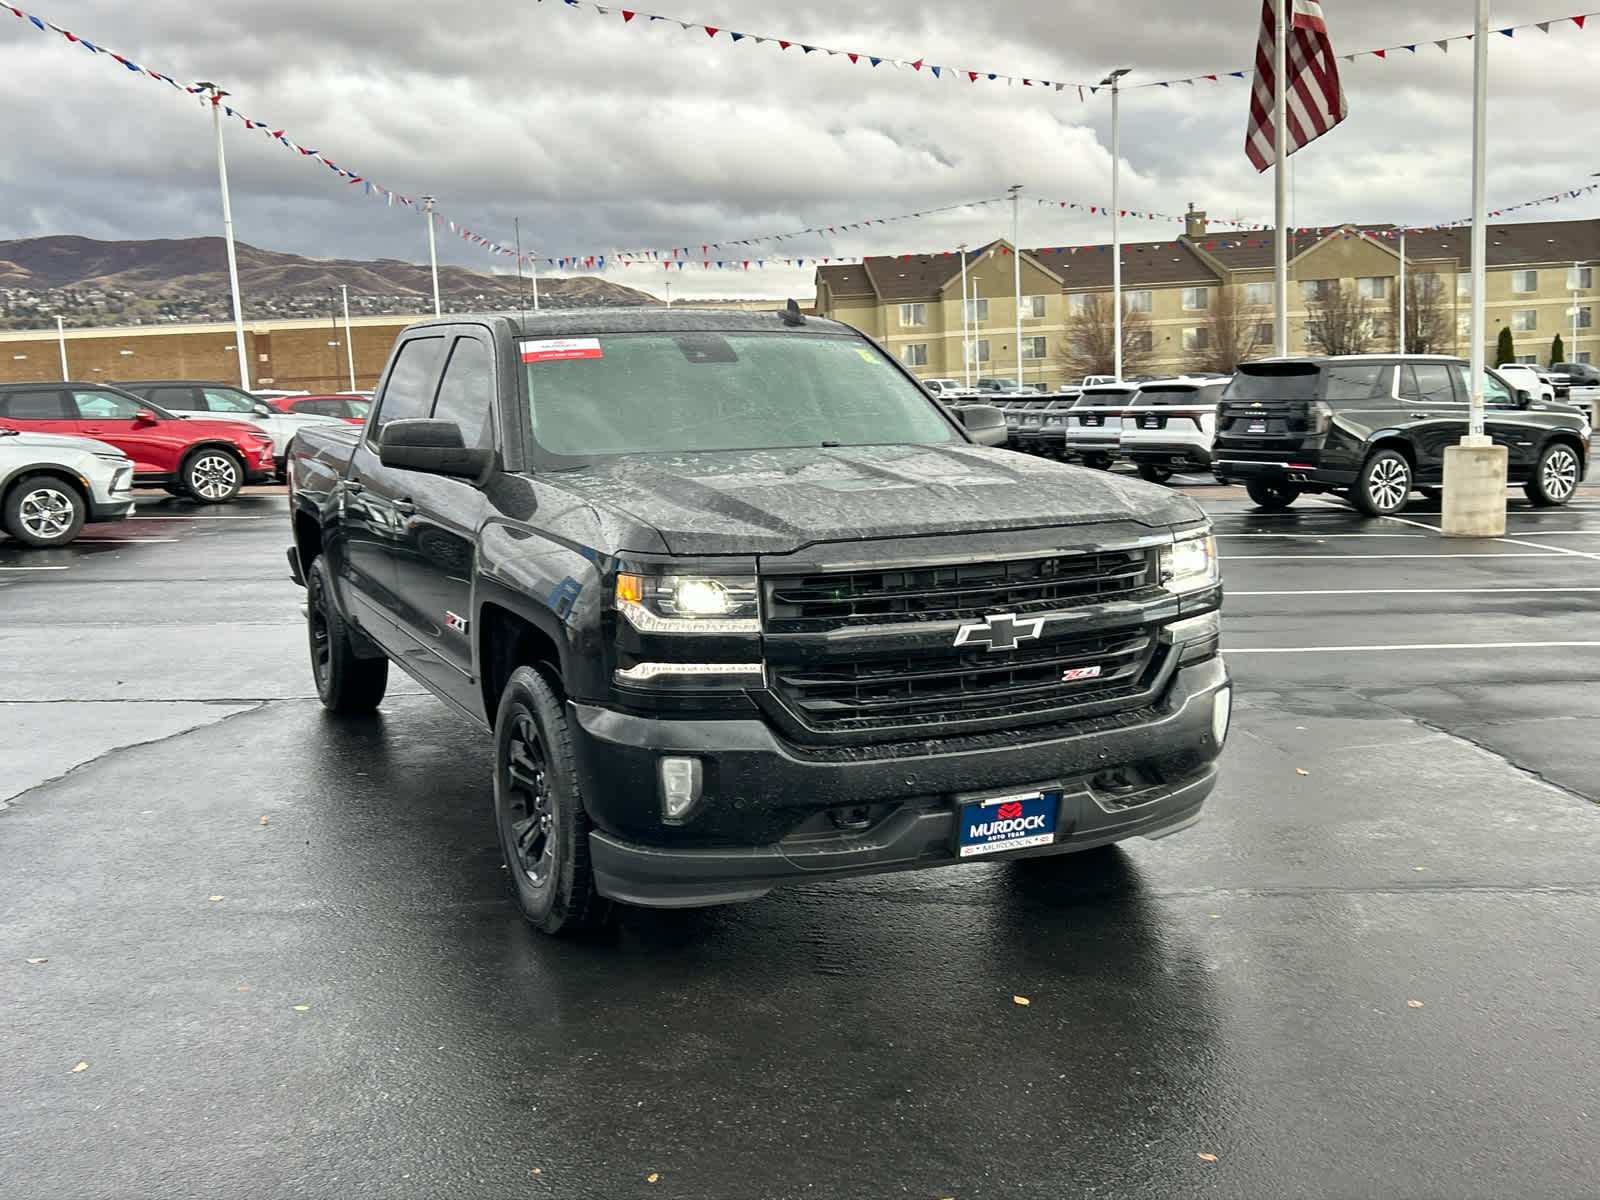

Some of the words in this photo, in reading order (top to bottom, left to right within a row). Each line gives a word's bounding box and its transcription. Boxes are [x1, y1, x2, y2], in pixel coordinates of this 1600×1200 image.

[969, 814, 1046, 838] MURDOCK
[987, 833, 1006, 841] AUTO
[1007, 830, 1025, 838] TEAM
